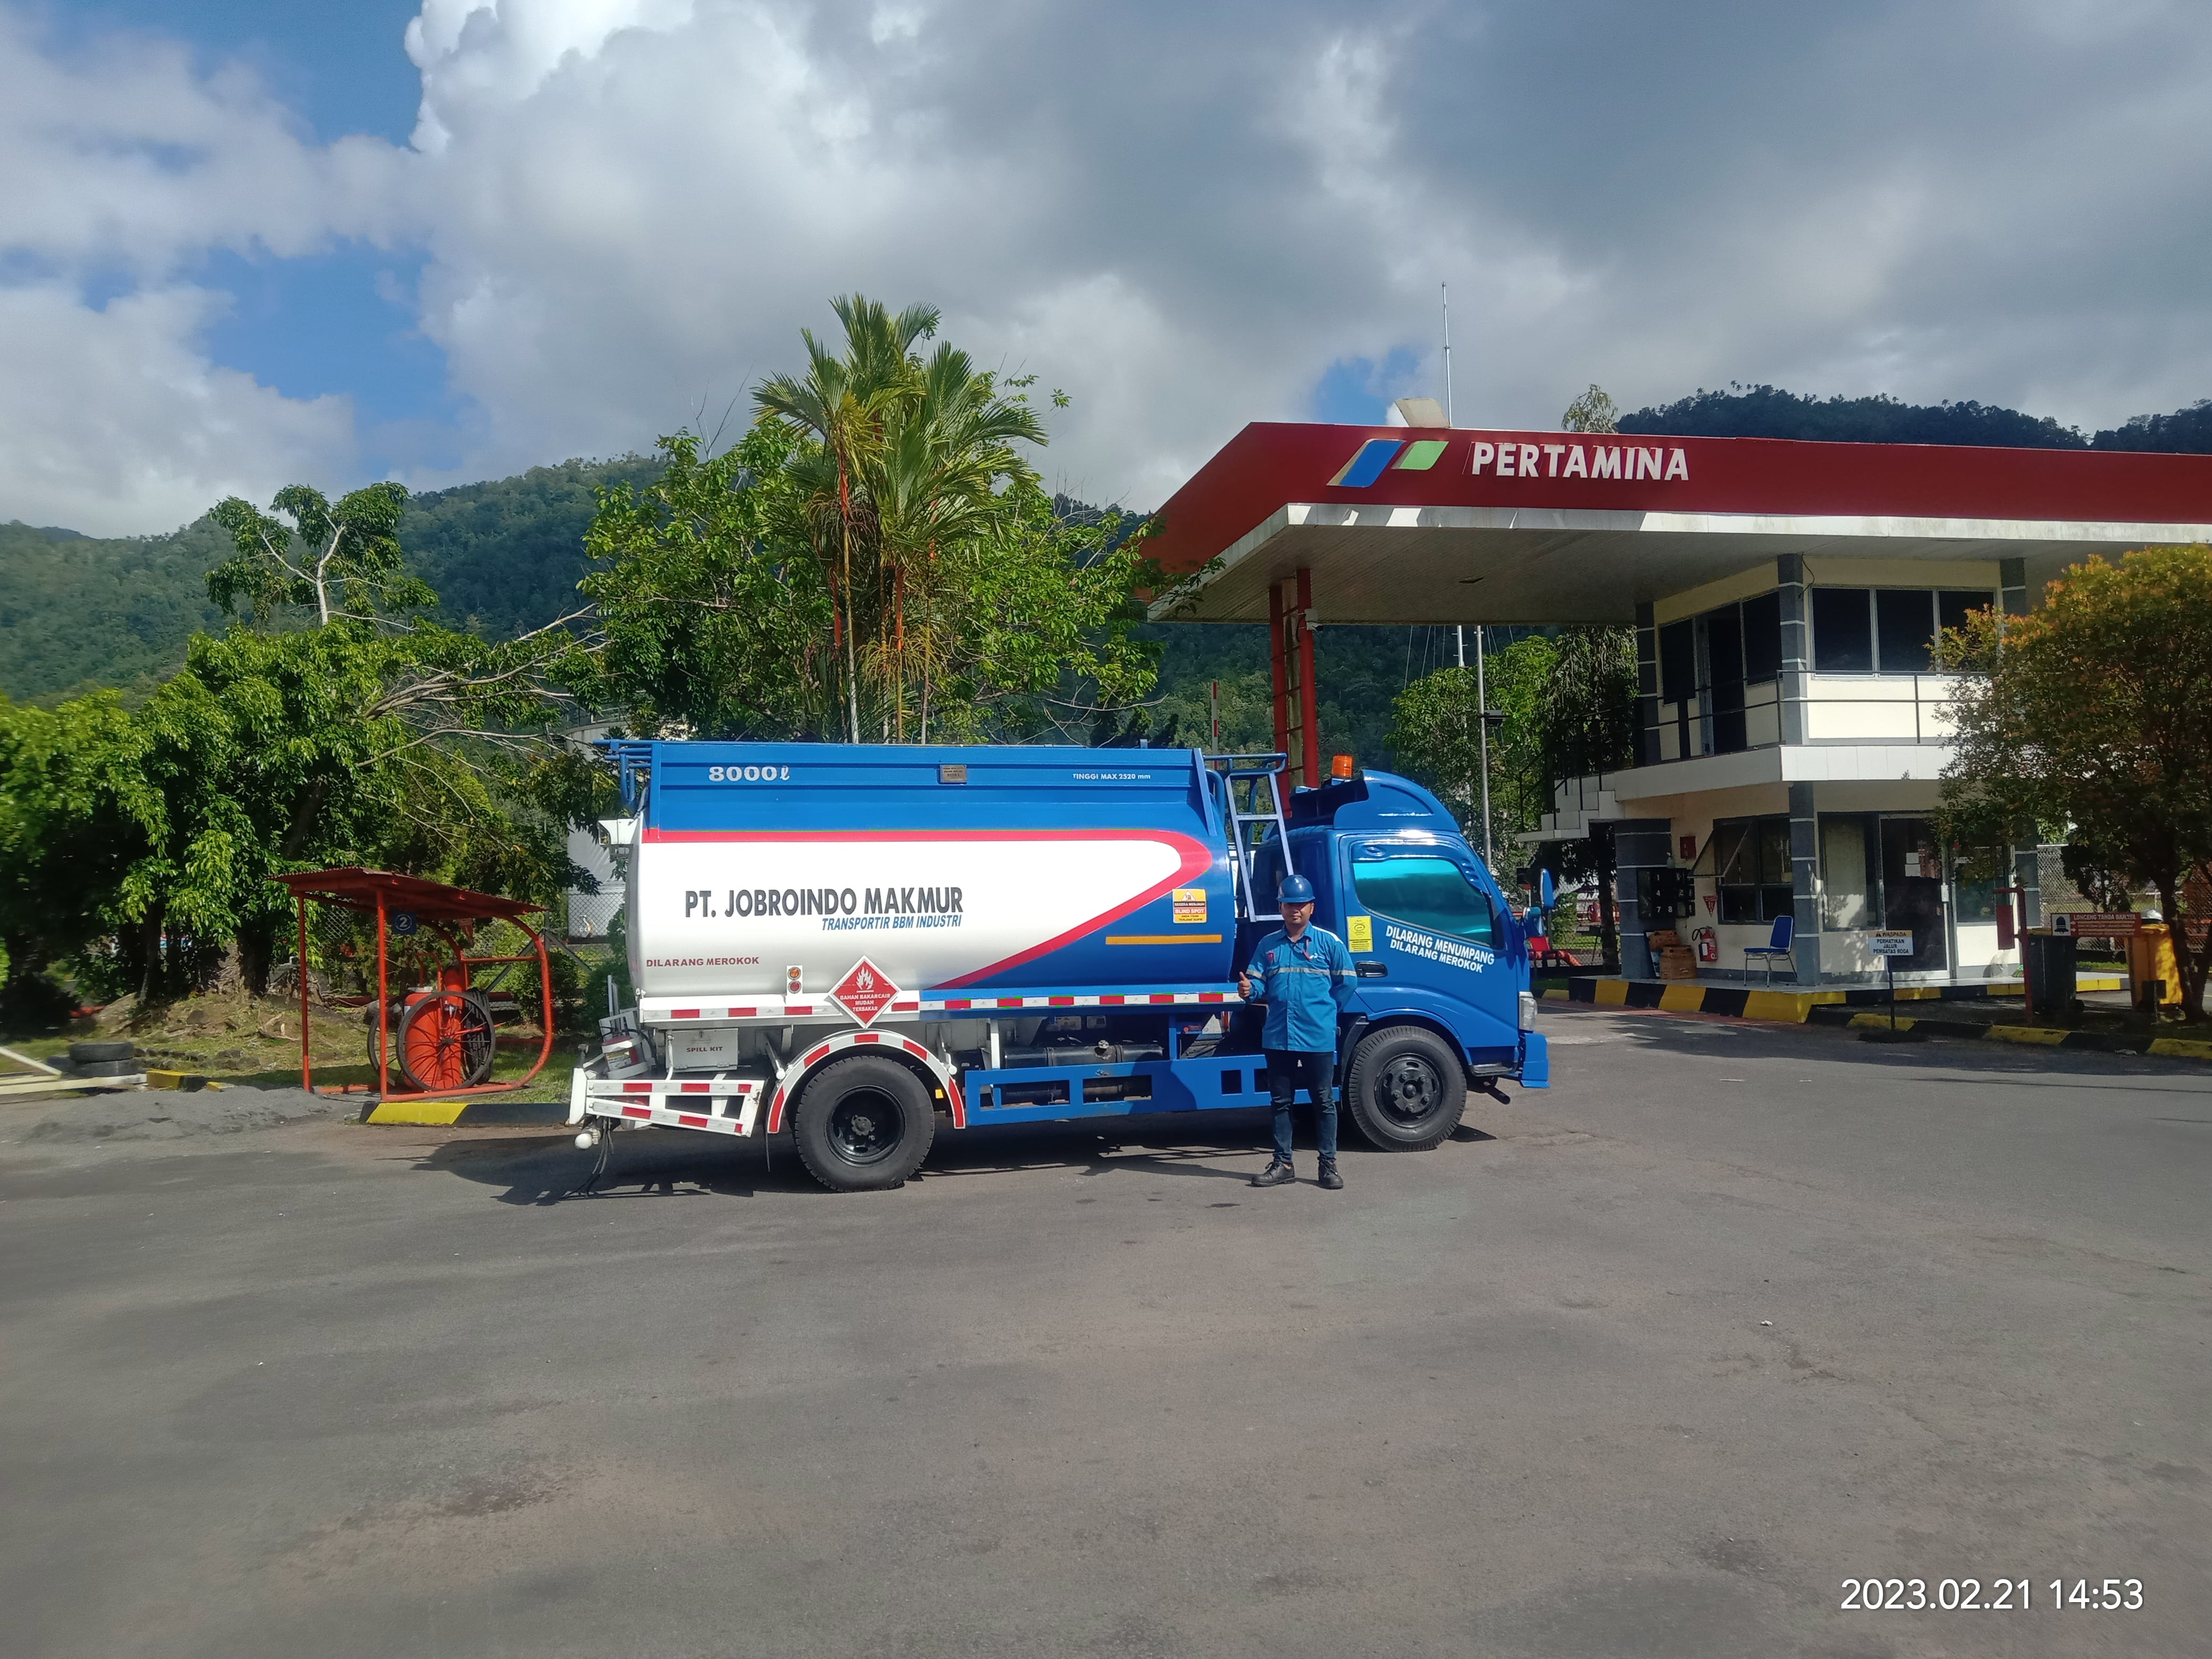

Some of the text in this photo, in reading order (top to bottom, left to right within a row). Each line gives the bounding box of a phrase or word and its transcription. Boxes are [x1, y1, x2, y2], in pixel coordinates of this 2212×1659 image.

[1471, 442, 1689, 481] PERTAMINA
[685, 887, 963, 918] PT. JOBROINDO MAKMUR
[399, 916, 408, 927] 2
[822, 915, 962, 931] TRANSPORTIR BBM INDUSTRI
[1386, 925, 1433, 948] DILARANG
[1434, 939, 1495, 965] MENUMPANG
[1390, 939, 1438, 960] DILARANG
[1438, 953, 1484, 973] MEROKOK
[646, 957, 760, 967] DILARANG MEROKOK
